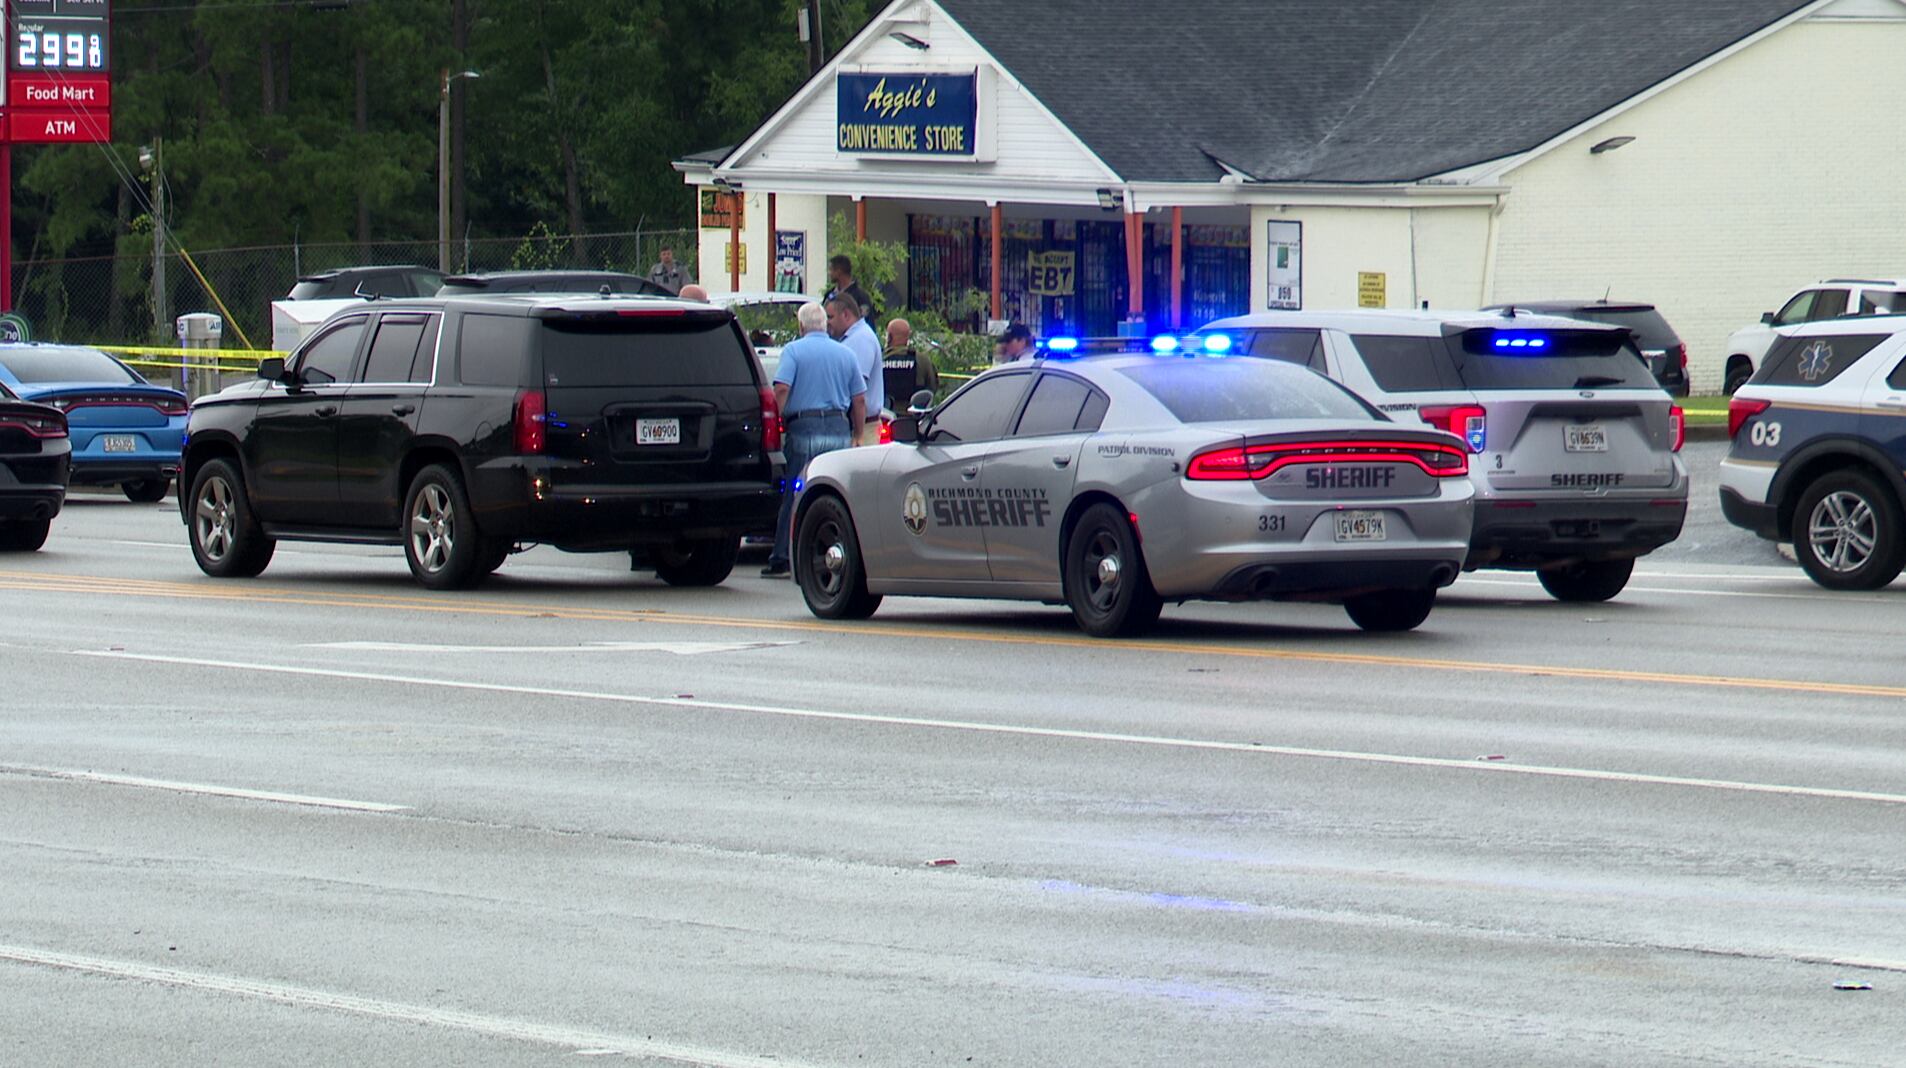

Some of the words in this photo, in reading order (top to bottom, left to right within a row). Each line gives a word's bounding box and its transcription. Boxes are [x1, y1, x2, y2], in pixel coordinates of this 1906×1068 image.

[18, 23, 44, 33] Regular
[26, 86, 59, 101] Food
[62, 86, 95, 101] Mart
[864, 77, 937, 118] Aggie's
[45, 121, 76, 135] ATM
[839, 123, 918, 150] CONVENIENCE
[924, 125, 964, 151] STORE
[1030, 265, 1073, 291] EBT
[1751, 420, 1782, 447] 03
[1097, 445, 1131, 455] PATROL
[1133, 446, 1175, 457] DIVISION
[1495, 454, 1503, 470] 3
[1306, 466, 1396, 489] SHERIFF
[1551, 473, 1625, 487] SHERIFF
[928, 487, 992, 499] RICHMOND
[997, 488, 1047, 499] COUNTY
[932, 499, 1051, 528] SHERIFF
[1258, 515, 1286, 531] 331
